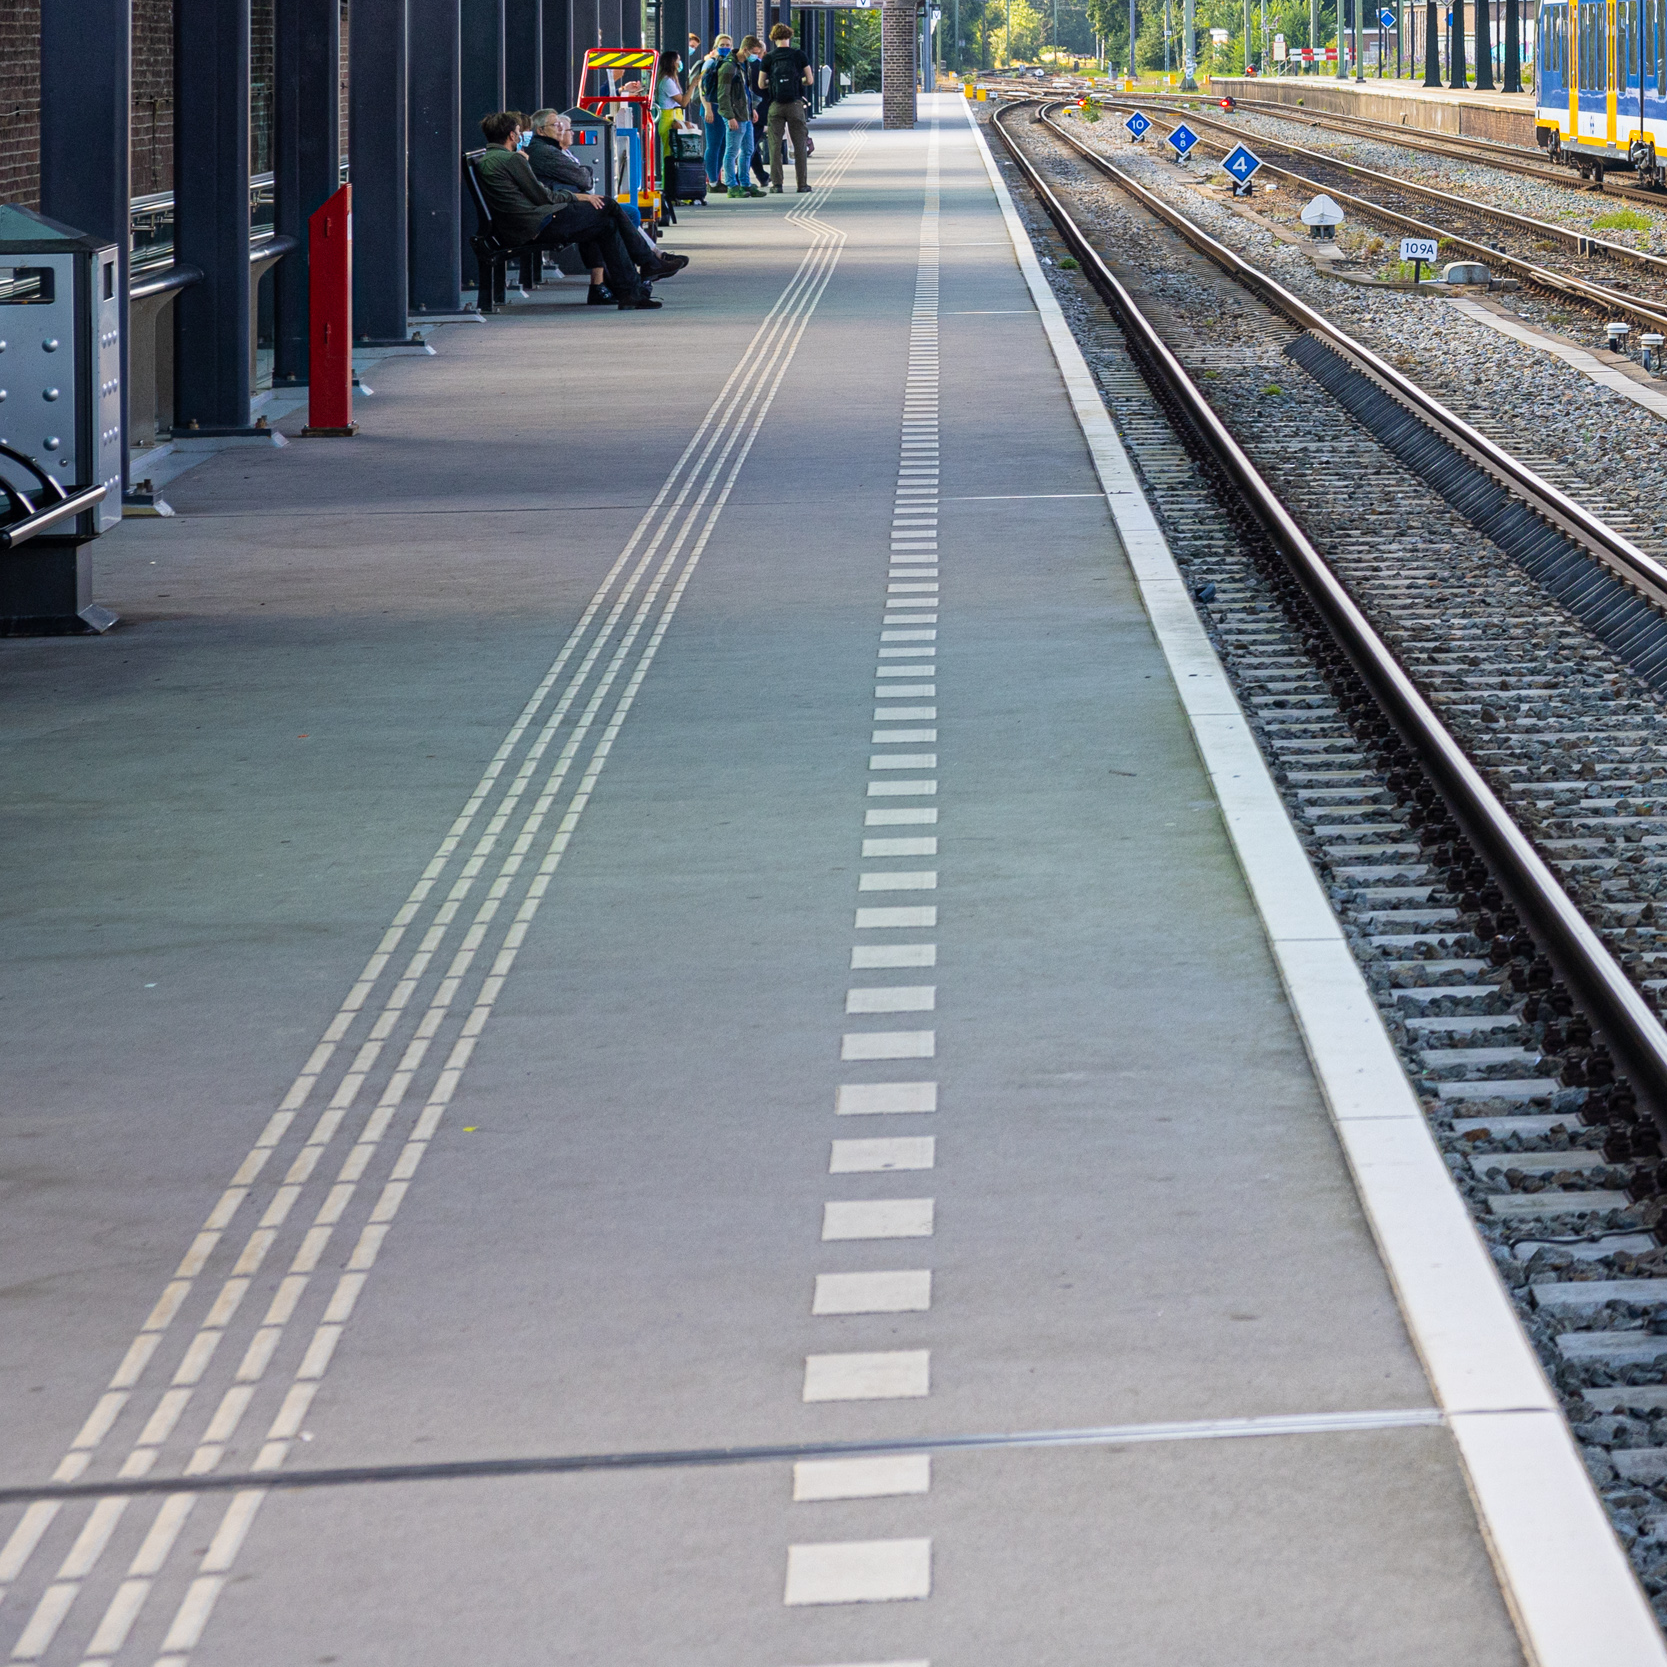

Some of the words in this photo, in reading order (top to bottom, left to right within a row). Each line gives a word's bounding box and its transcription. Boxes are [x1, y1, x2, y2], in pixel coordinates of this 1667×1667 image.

[1131, 120, 1145, 129] 10
[1180, 131, 1186, 139] 6
[1232, 156, 1248, 172] 4
[1405, 243, 1434, 254] 109A
